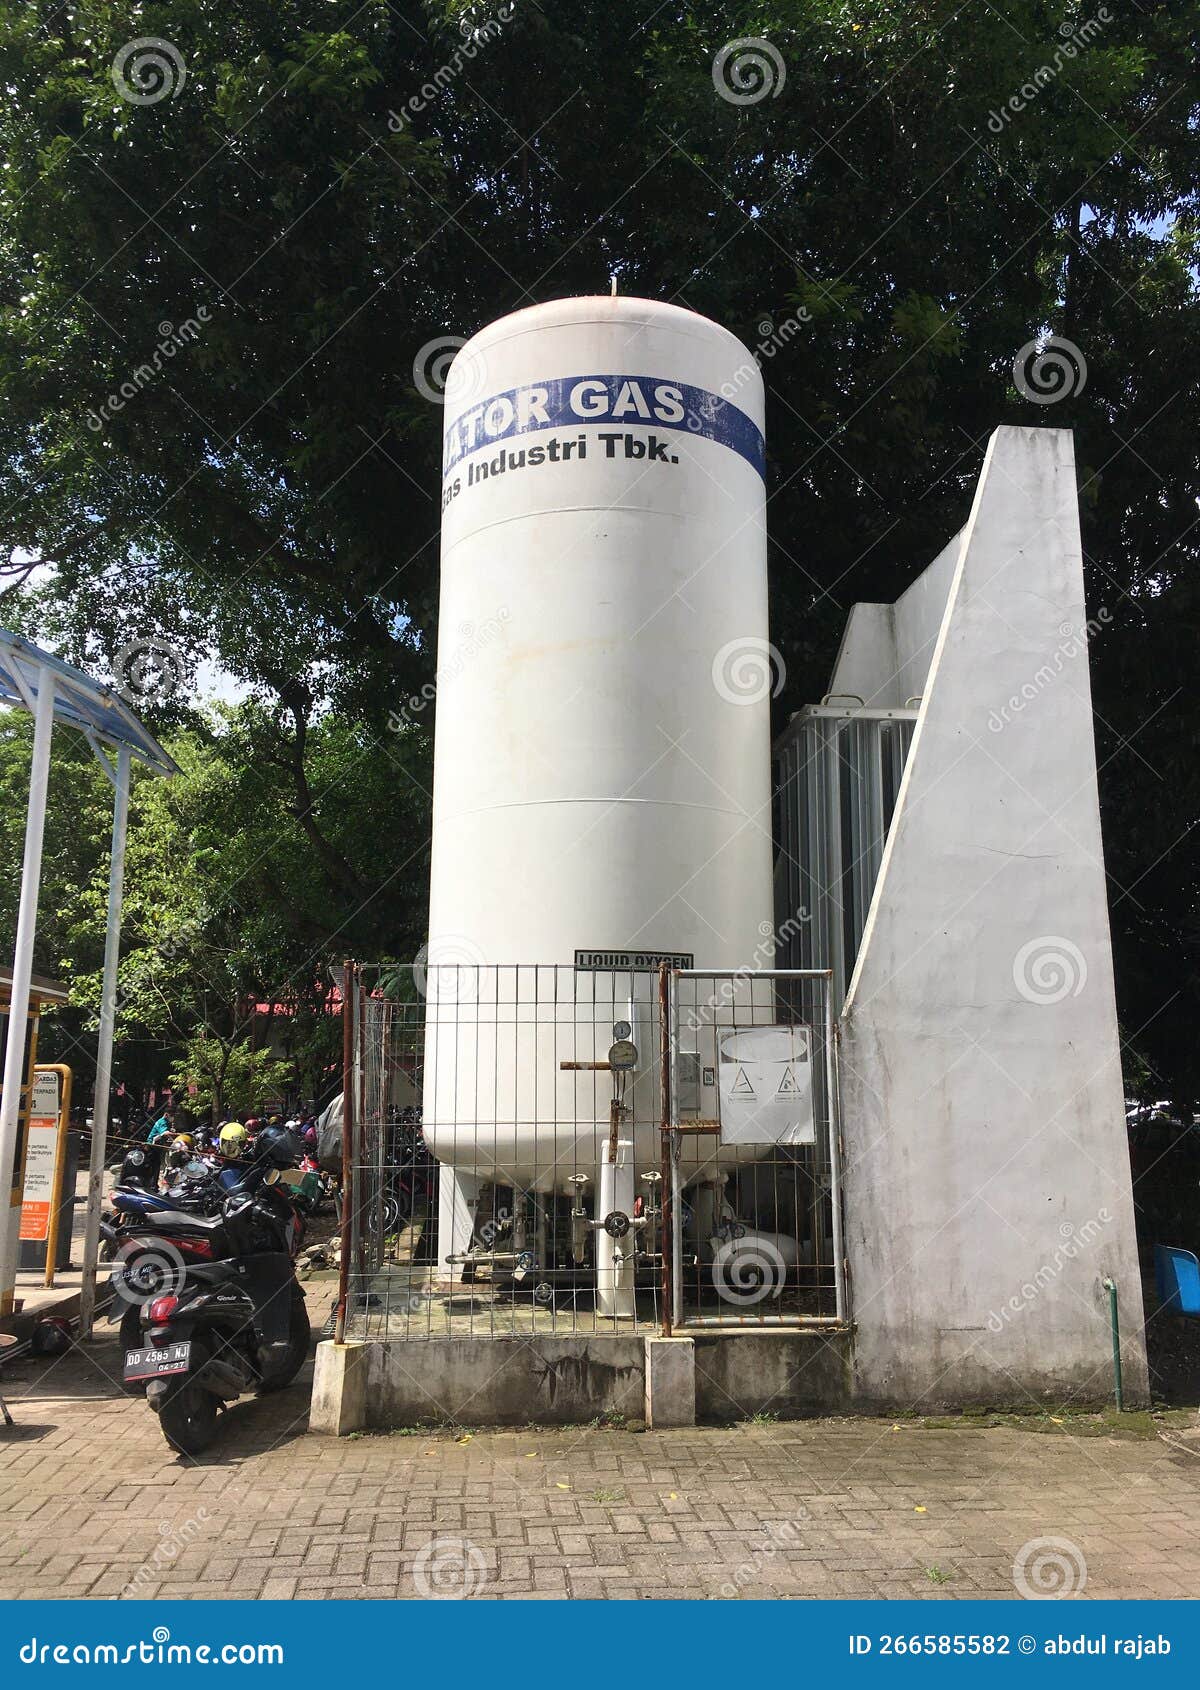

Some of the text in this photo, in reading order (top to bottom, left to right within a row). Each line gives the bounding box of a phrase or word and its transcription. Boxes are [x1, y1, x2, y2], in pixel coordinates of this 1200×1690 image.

[569, 380, 685, 423] GAS
[468, 434, 586, 487] Industri
[598, 433, 679, 464] Tbk.
[579, 953, 690, 970] LIQUID OXYGEN
[128, 1353, 141, 1366] DD
[145, 1349, 169, 1362] 4585
